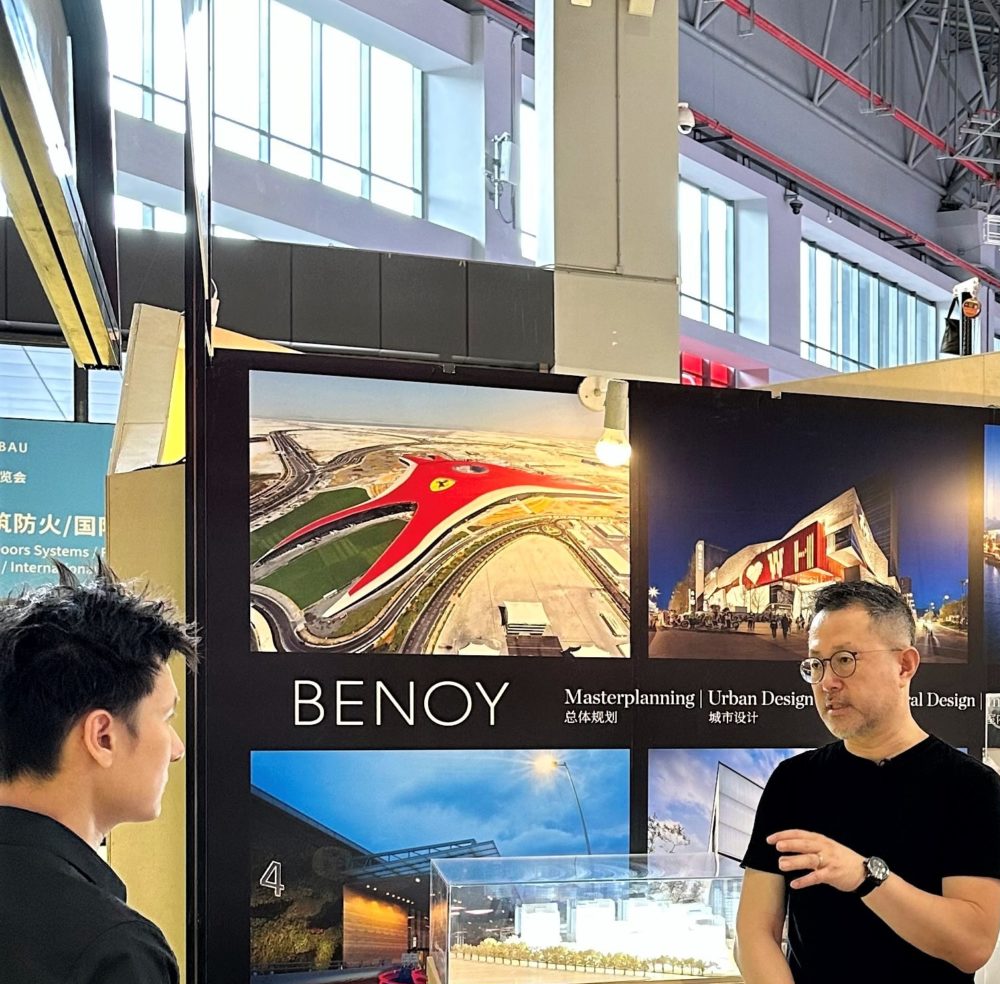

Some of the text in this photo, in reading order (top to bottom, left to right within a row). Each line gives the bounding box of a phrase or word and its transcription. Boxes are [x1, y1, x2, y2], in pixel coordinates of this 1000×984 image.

[0, 441, 28, 453] BAU
[0, 512, 106, 537] 筑防火/国
[33, 544, 90, 559] Systems
[293, 680, 510, 727] BENOY
[564, 688, 696, 709] Masterplanning
[708, 690, 758, 706] Urban
[761, 690, 814, 710] Design
[926, 692, 976, 710] Design
[564, 710, 618, 724] 总体规划
[708, 711, 759, 725] 城市设计
[259, 860, 285, 897] 4
